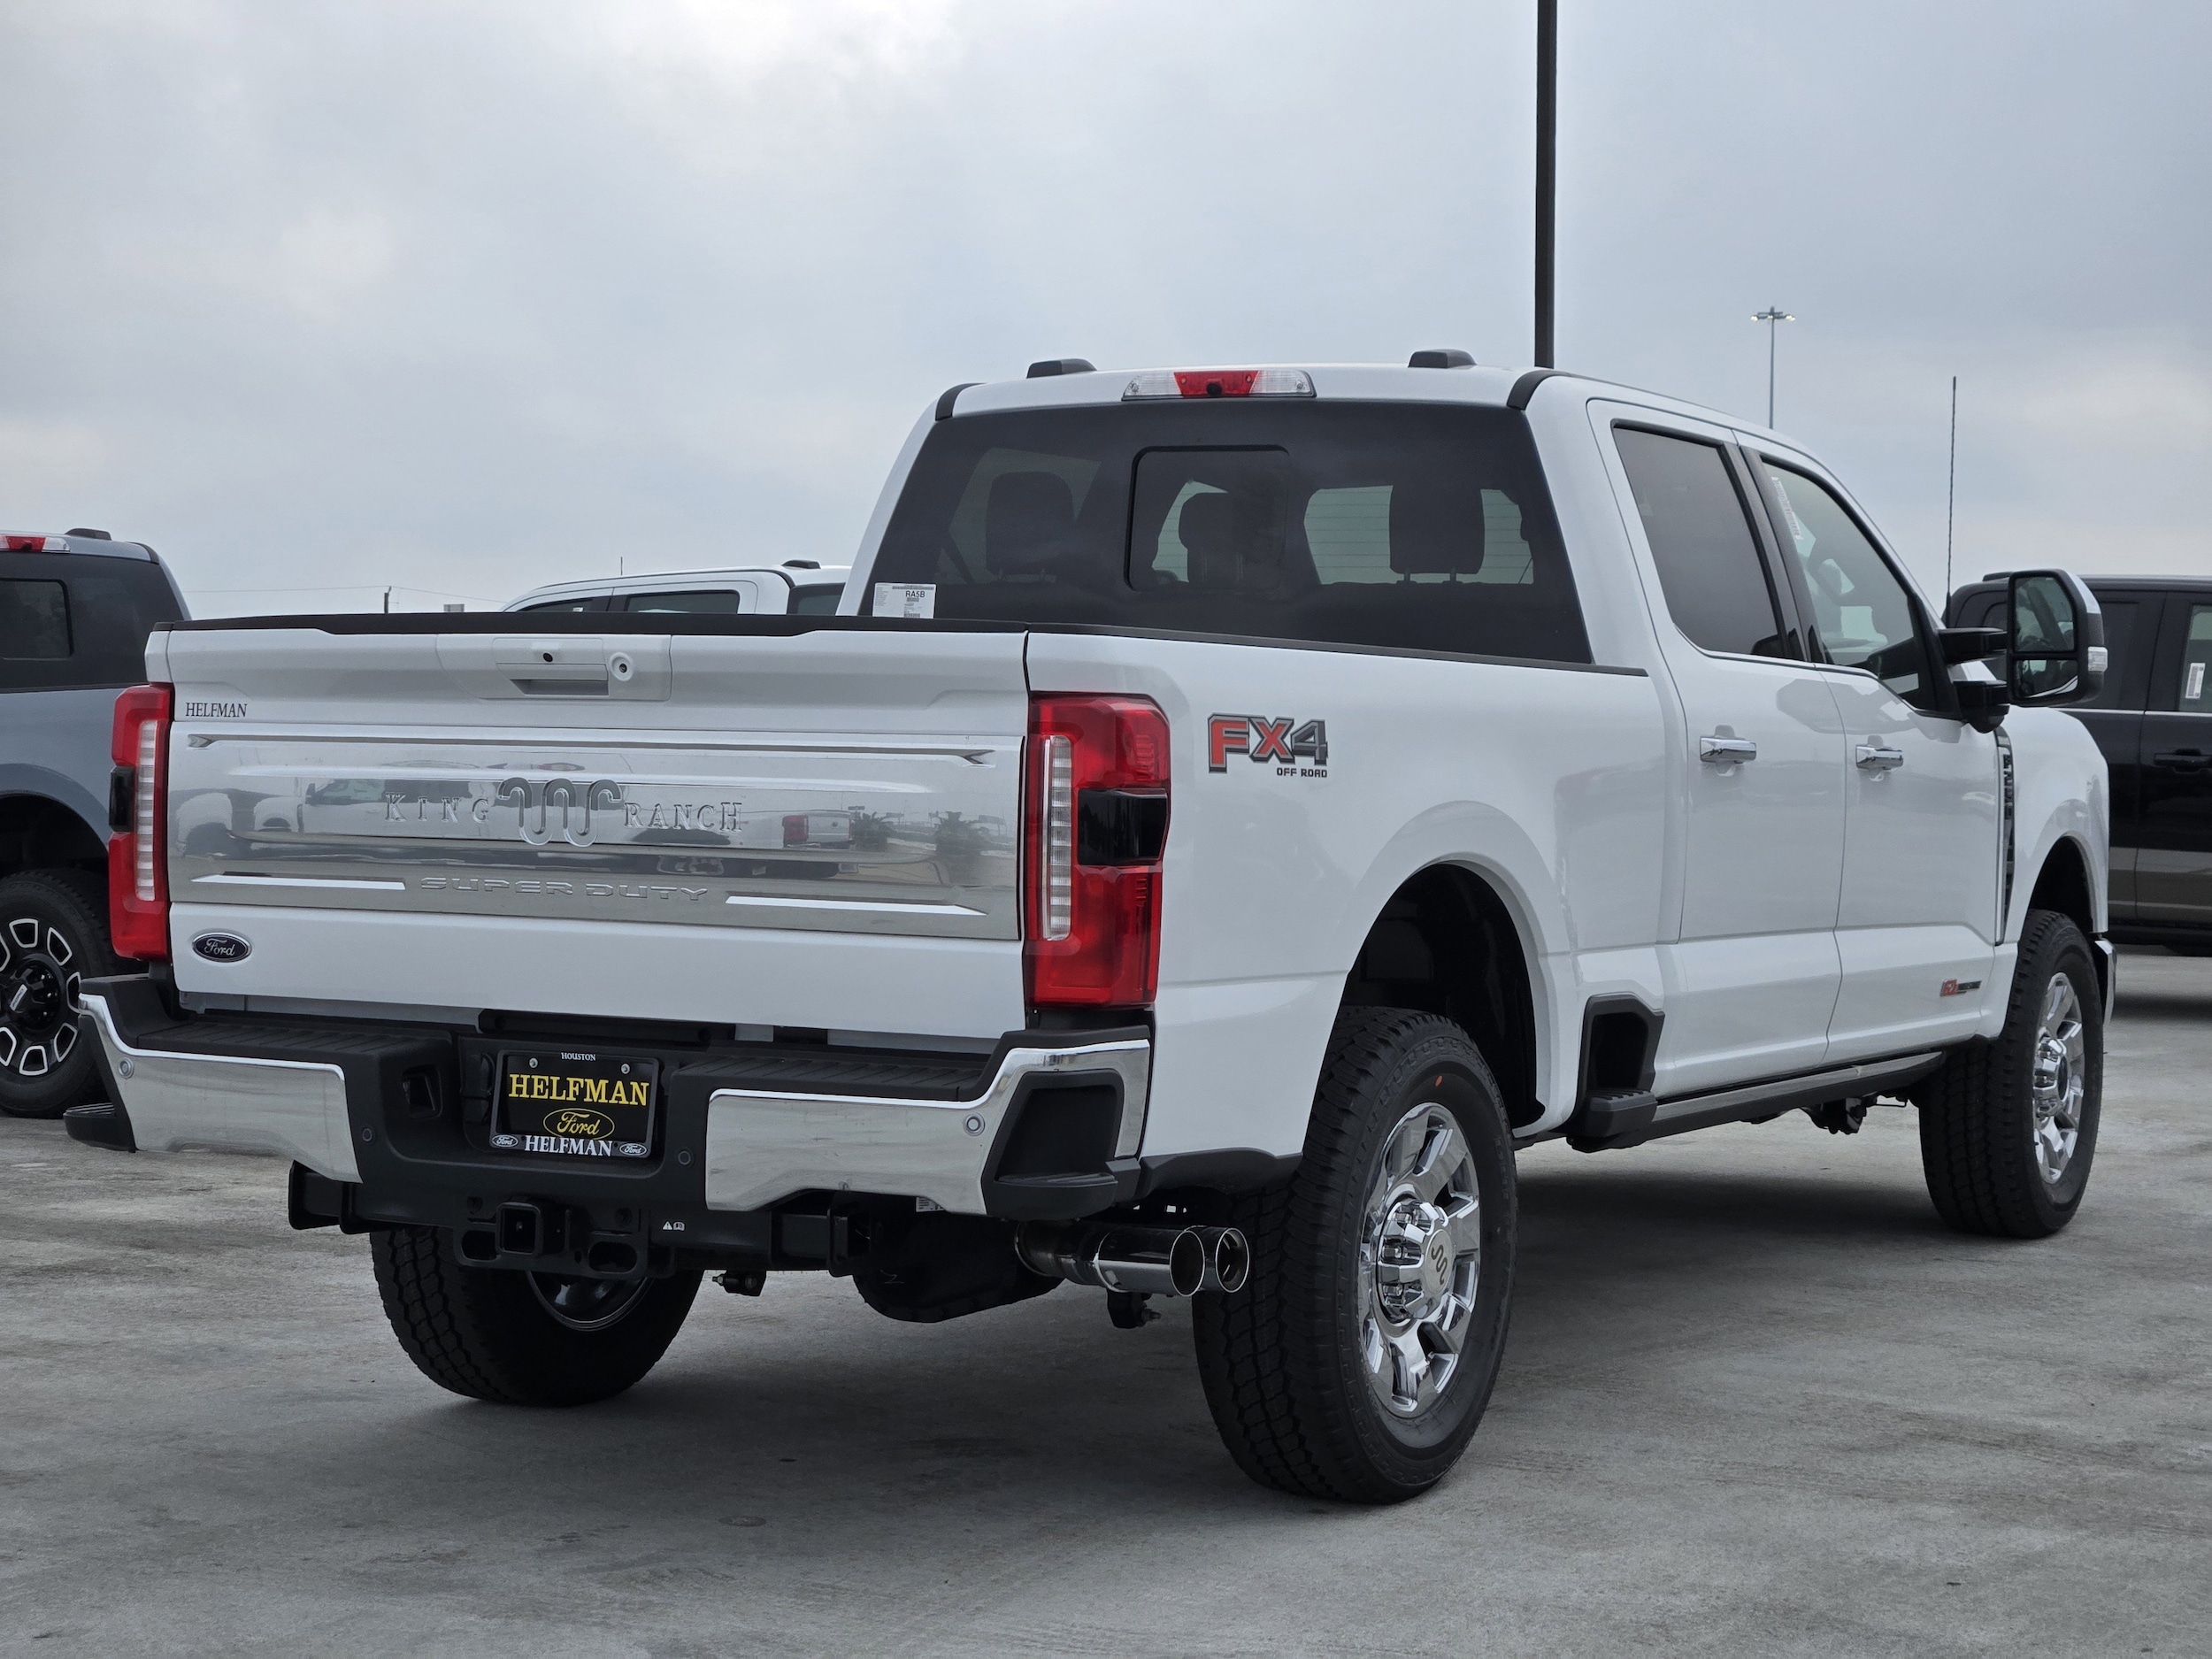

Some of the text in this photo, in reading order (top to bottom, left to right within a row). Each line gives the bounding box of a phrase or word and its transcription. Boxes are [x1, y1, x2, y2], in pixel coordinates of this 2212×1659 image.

[185, 702, 248, 718] HELFMAN
[1208, 712, 1328, 773] FX4
[1276, 766, 1327, 778] OFF ROAD
[385, 792, 743, 833] KING RANCH
[420, 877, 708, 902] SUPER DUTY
[204, 938, 236, 956] Ford
[560, 1051, 596, 1062] HOUSTON
[508, 1073, 649, 1107] HELFMAN
[557, 1110, 601, 1136] Ford
[524, 1134, 613, 1157] HELFMAN
